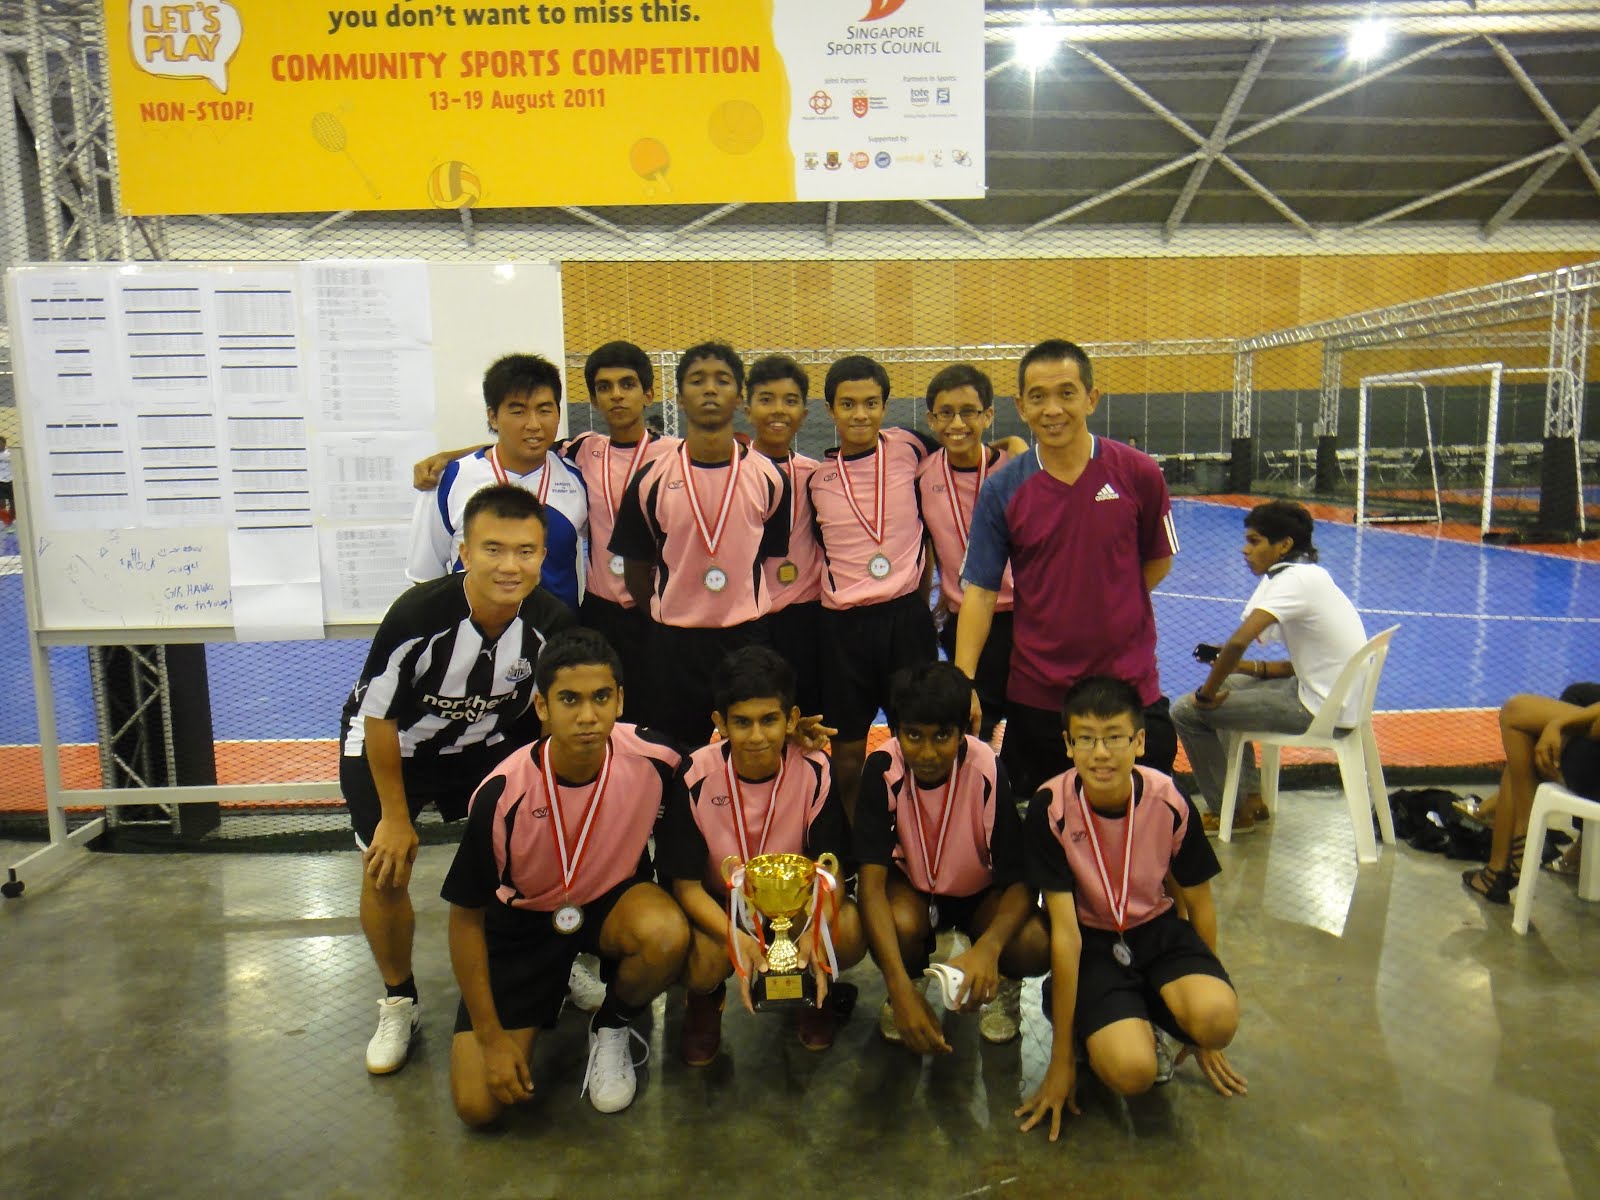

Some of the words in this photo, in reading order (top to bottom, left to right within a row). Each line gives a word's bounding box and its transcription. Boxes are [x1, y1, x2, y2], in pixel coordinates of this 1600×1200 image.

[143, 2, 221, 33] LET'S
[328, 9, 378, 35] you
[386, 3, 456, 27] don't
[464, 4, 531, 27] want
[538, 4, 566, 25] to
[574, 2, 633, 24] miss
[640, 1, 700, 23] this.
[846, 25, 925, 40] SINGAPORE
[144, 34, 221, 63] PLAY
[826, 41, 878, 56] SPORTS
[881, 40, 943, 55] COUNCIL
[271, 51, 447, 82] COMMUNITY
[460, 48, 560, 79] SPORTS
[572, 45, 760, 77] COMPETITION
[140, 101, 254, 122] NON-STOP!
[491, 88, 556, 115] August
[564, 87, 606, 109] 2011
